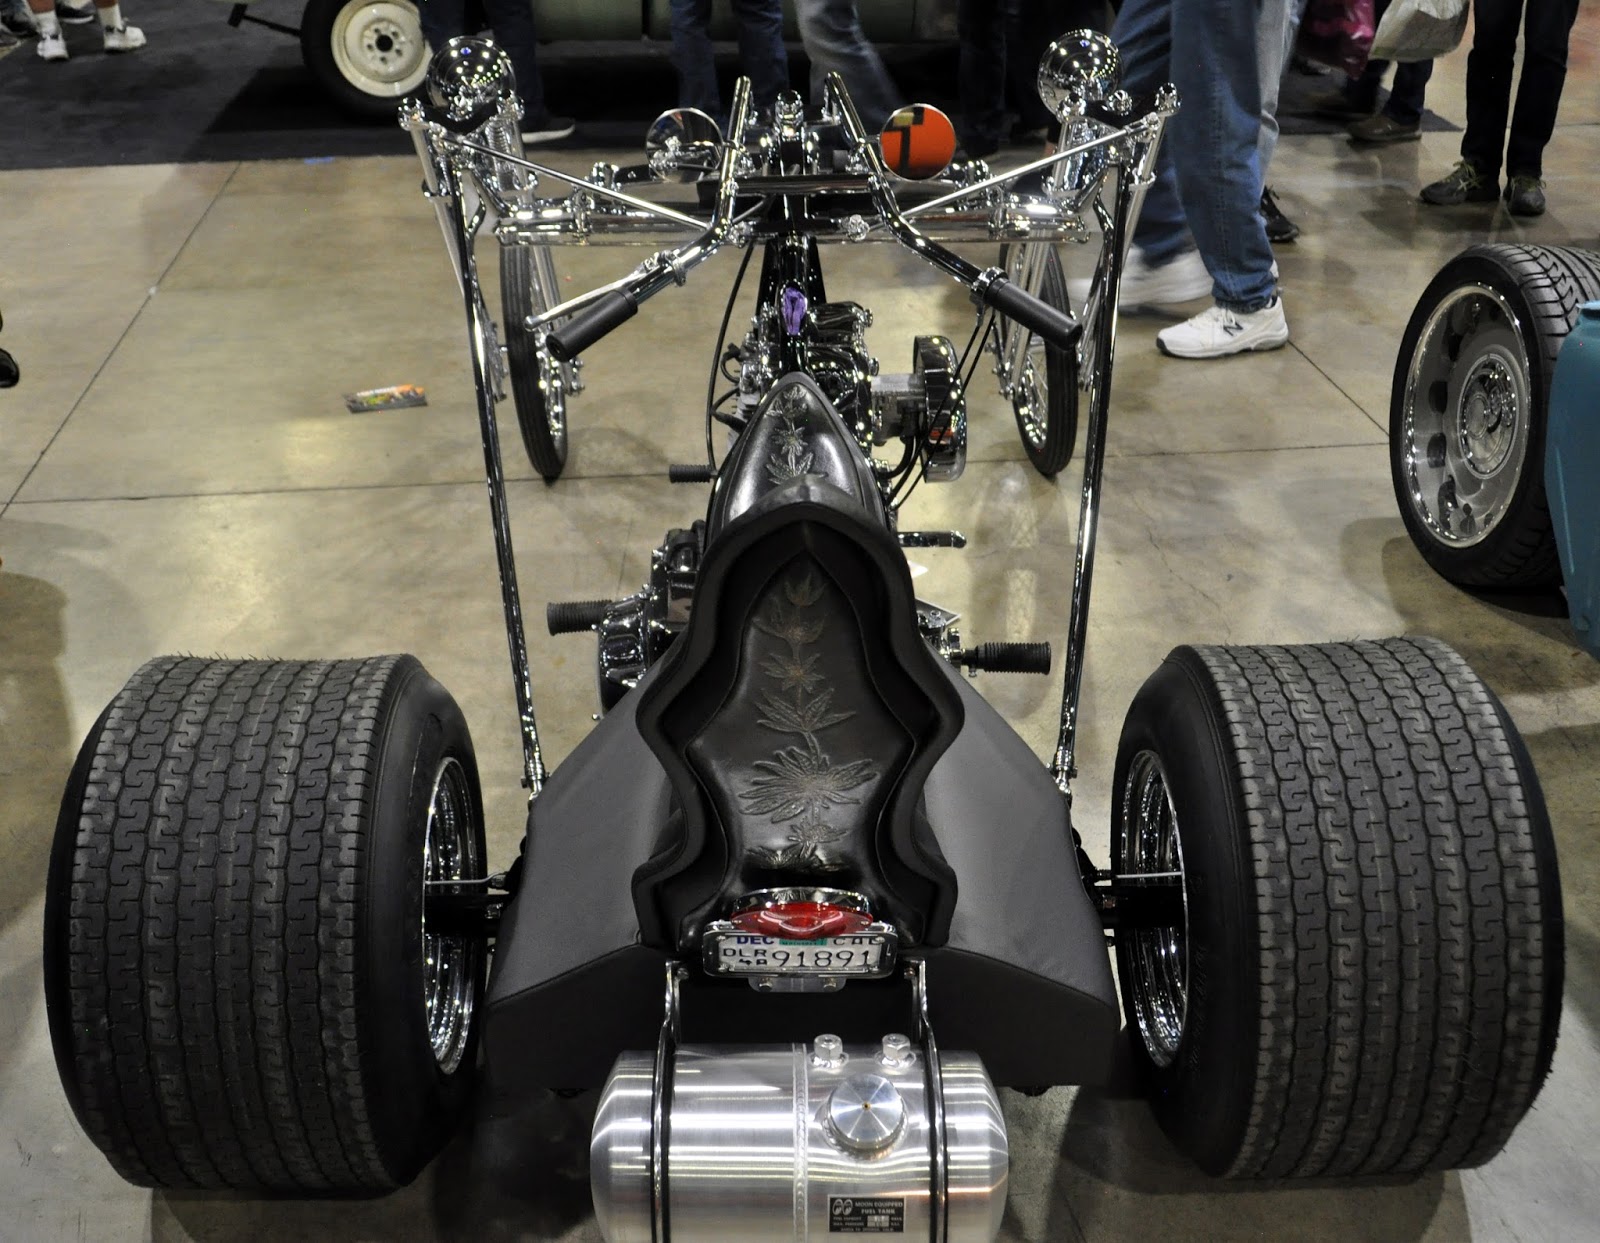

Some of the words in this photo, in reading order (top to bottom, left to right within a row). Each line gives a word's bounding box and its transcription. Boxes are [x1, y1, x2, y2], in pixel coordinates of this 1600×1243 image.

[736, 936, 774, 945] DEC
[723, 948, 767, 957] DLR
[772, 950, 870, 967] 91891
